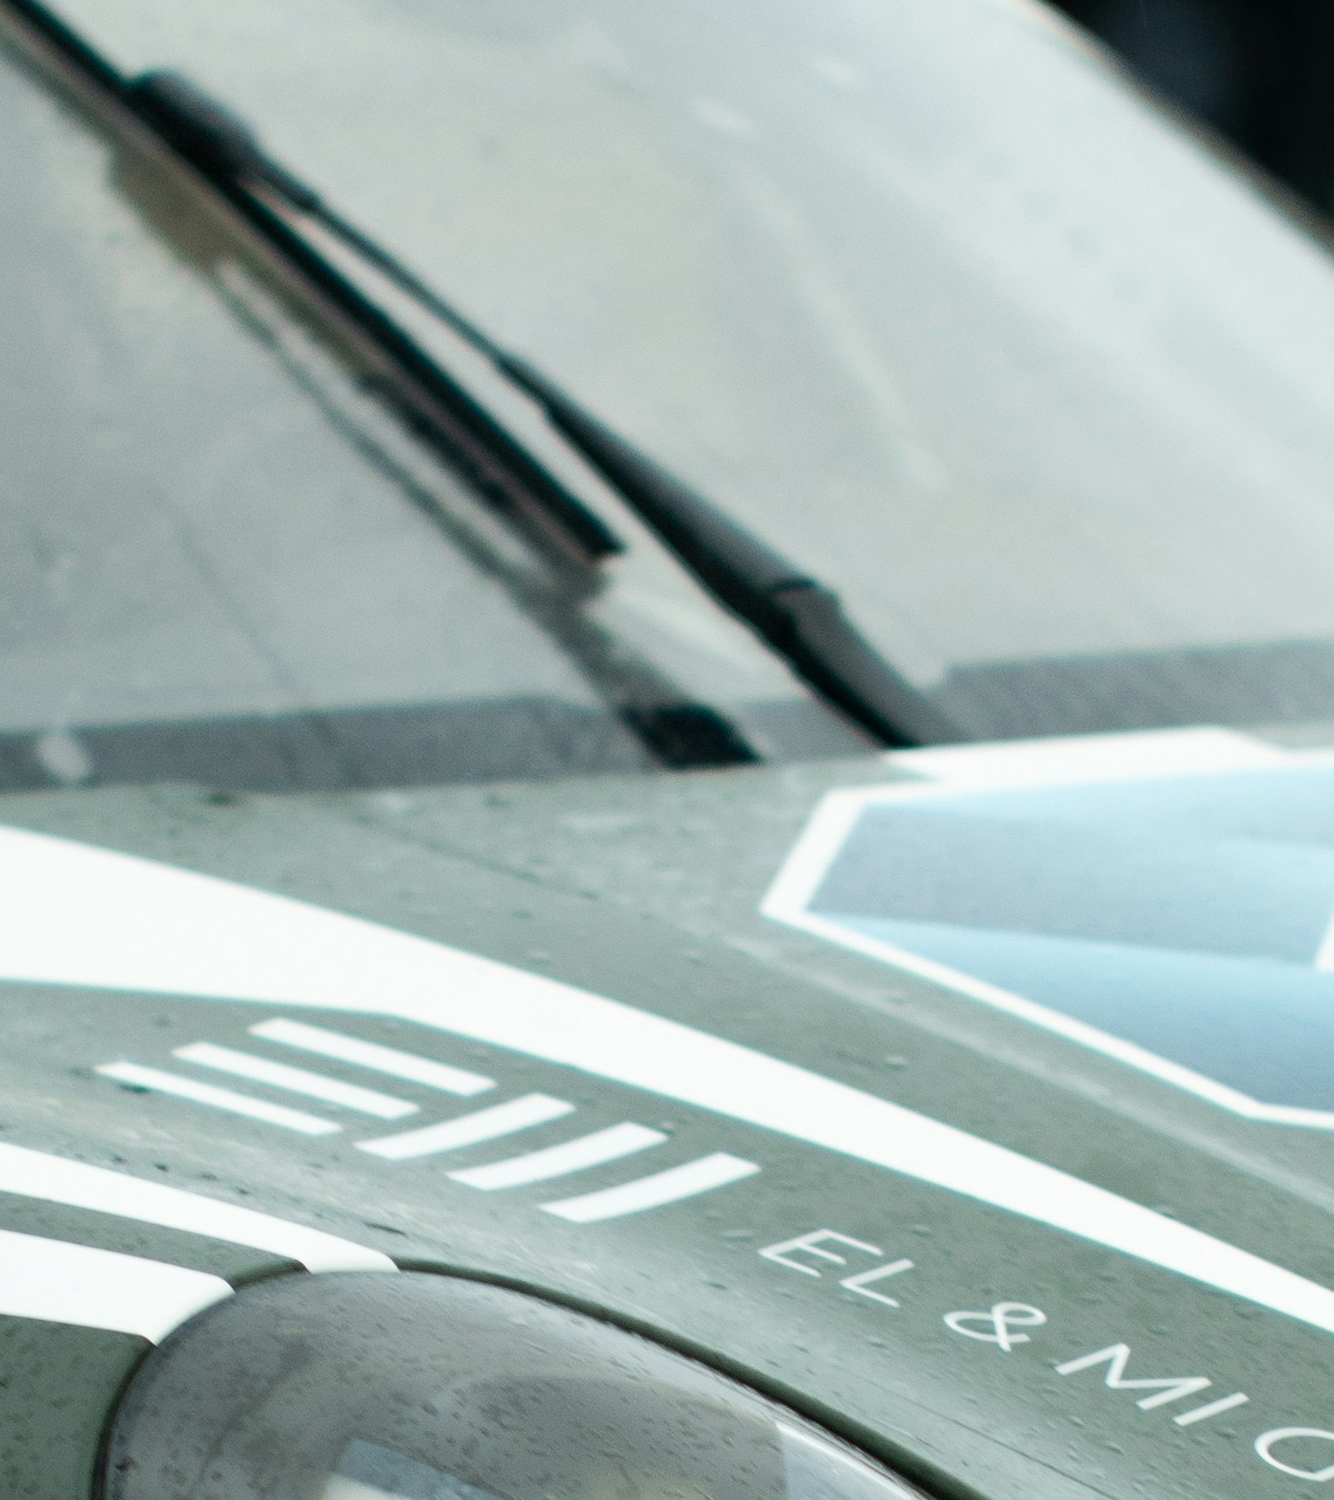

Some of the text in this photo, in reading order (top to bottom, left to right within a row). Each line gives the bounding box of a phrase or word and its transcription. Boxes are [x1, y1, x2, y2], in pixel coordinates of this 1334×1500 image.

[756, 1227, 922, 1311] EL
[942, 1300, 1049, 1353] &
[1054, 1343, 1248, 1430] MI
